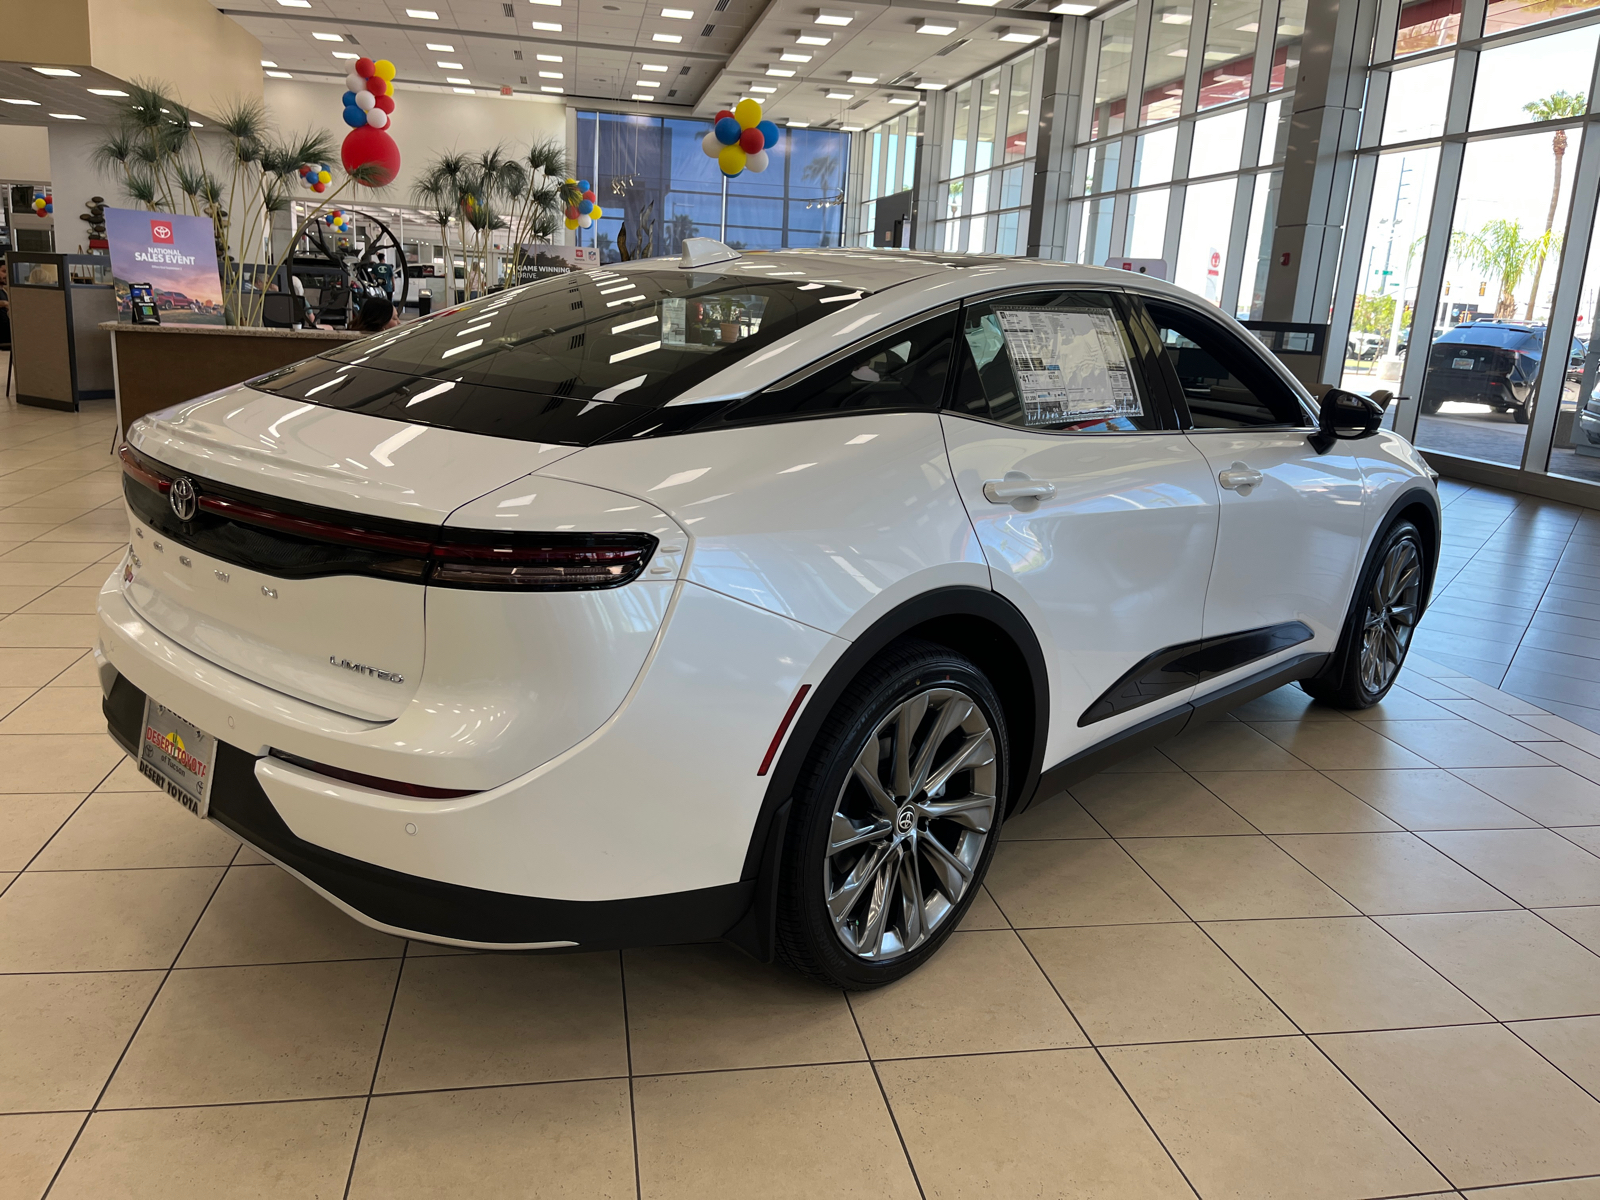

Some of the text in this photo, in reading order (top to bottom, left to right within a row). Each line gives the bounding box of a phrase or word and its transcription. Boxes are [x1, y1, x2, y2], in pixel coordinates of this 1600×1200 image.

[135, 252, 196, 265] SALES EVENT
[148, 247, 182, 256] NATIONAL
[136, 527, 279, 600] CROWN
[329, 655, 405, 684] LIMITED
[146, 726, 175, 756] DESERT
[167, 758, 186, 777] Tucson
[139, 761, 199, 815] DESERT TOYOTA
